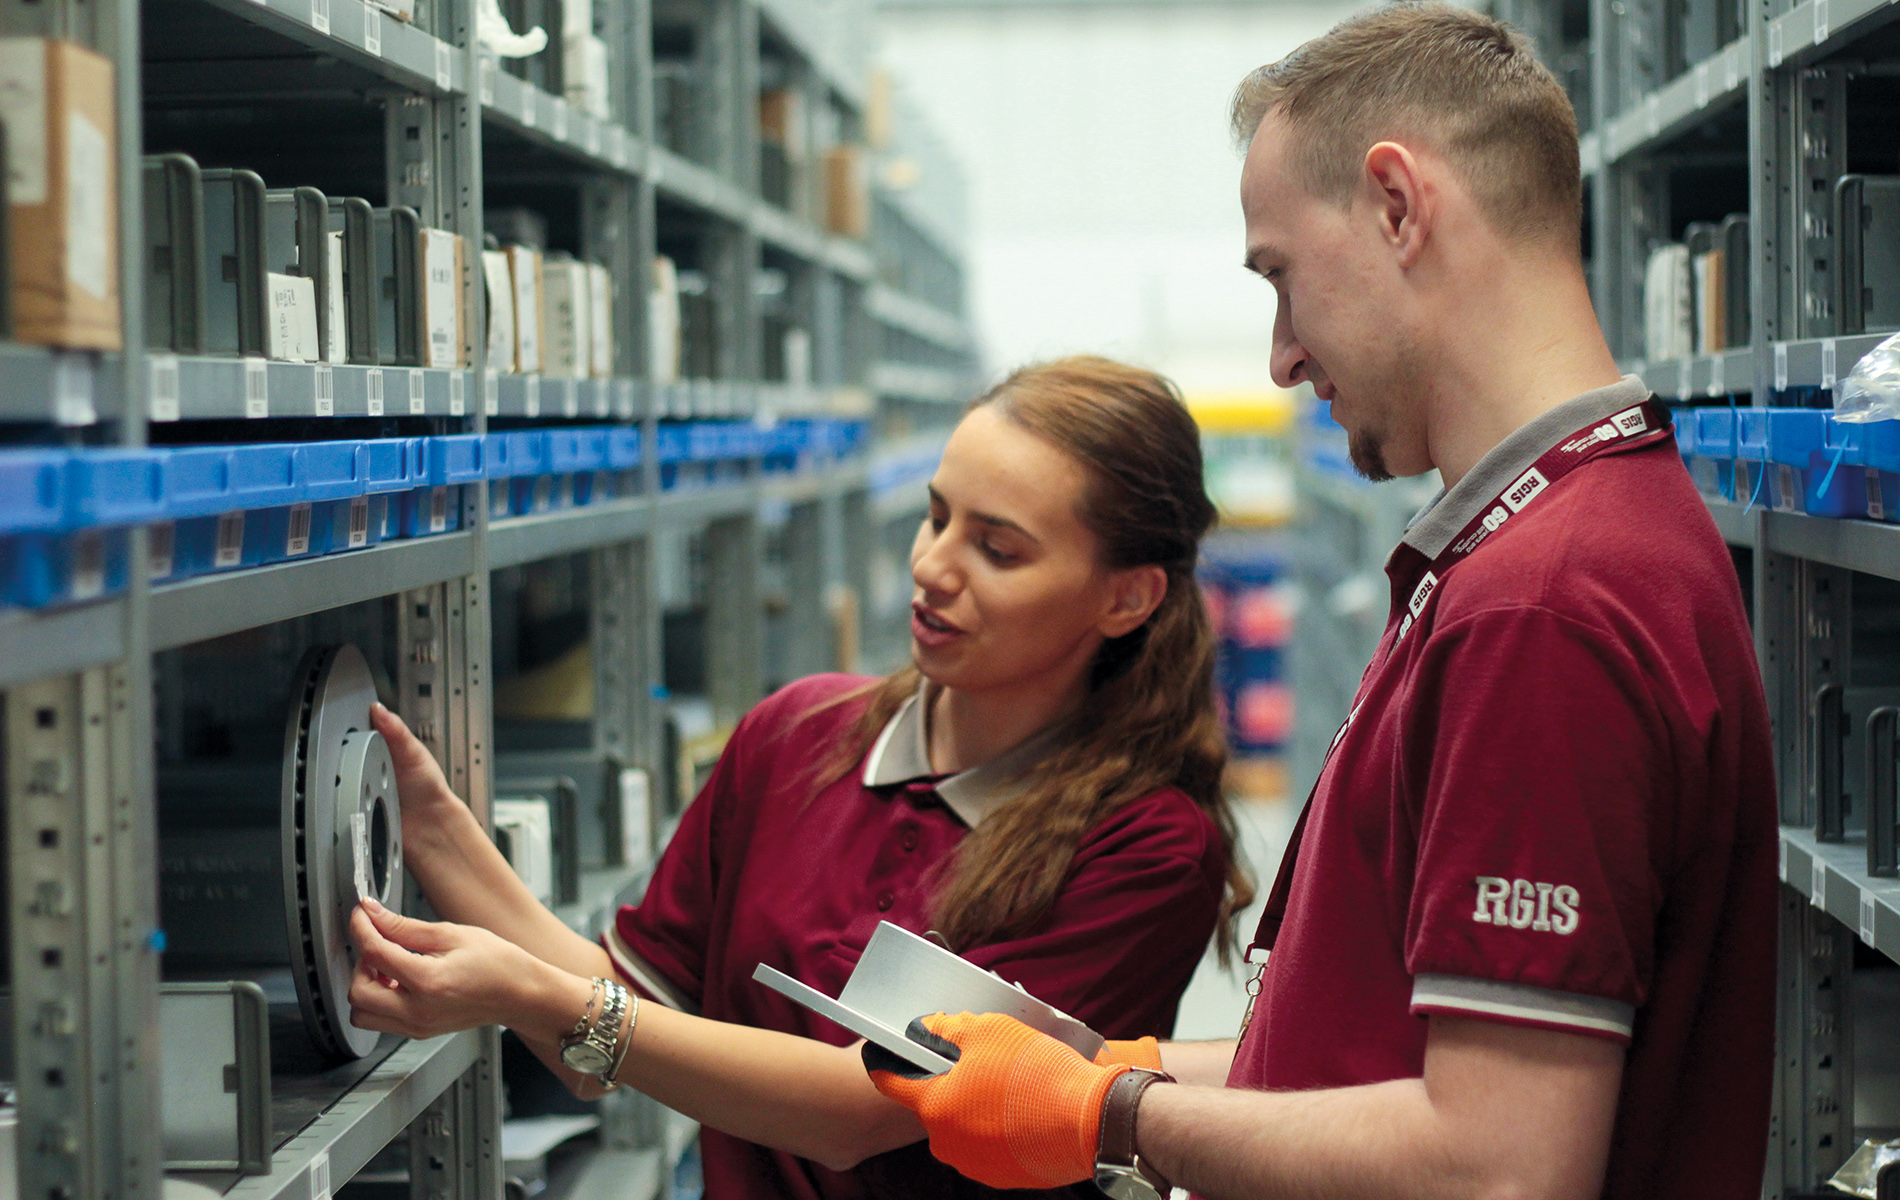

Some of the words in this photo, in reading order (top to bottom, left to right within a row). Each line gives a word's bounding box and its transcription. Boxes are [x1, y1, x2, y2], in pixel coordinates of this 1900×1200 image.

[1593, 424, 1619, 441] 60
[1620, 413, 1643, 430] RGIS
[1510, 475, 1540, 504] RGIS
[1482, 505, 1509, 532] 60
[1413, 579, 1434, 610] RGIS
[1399, 612, 1413, 640] 60
[1473, 876, 1579, 934] RGIS
